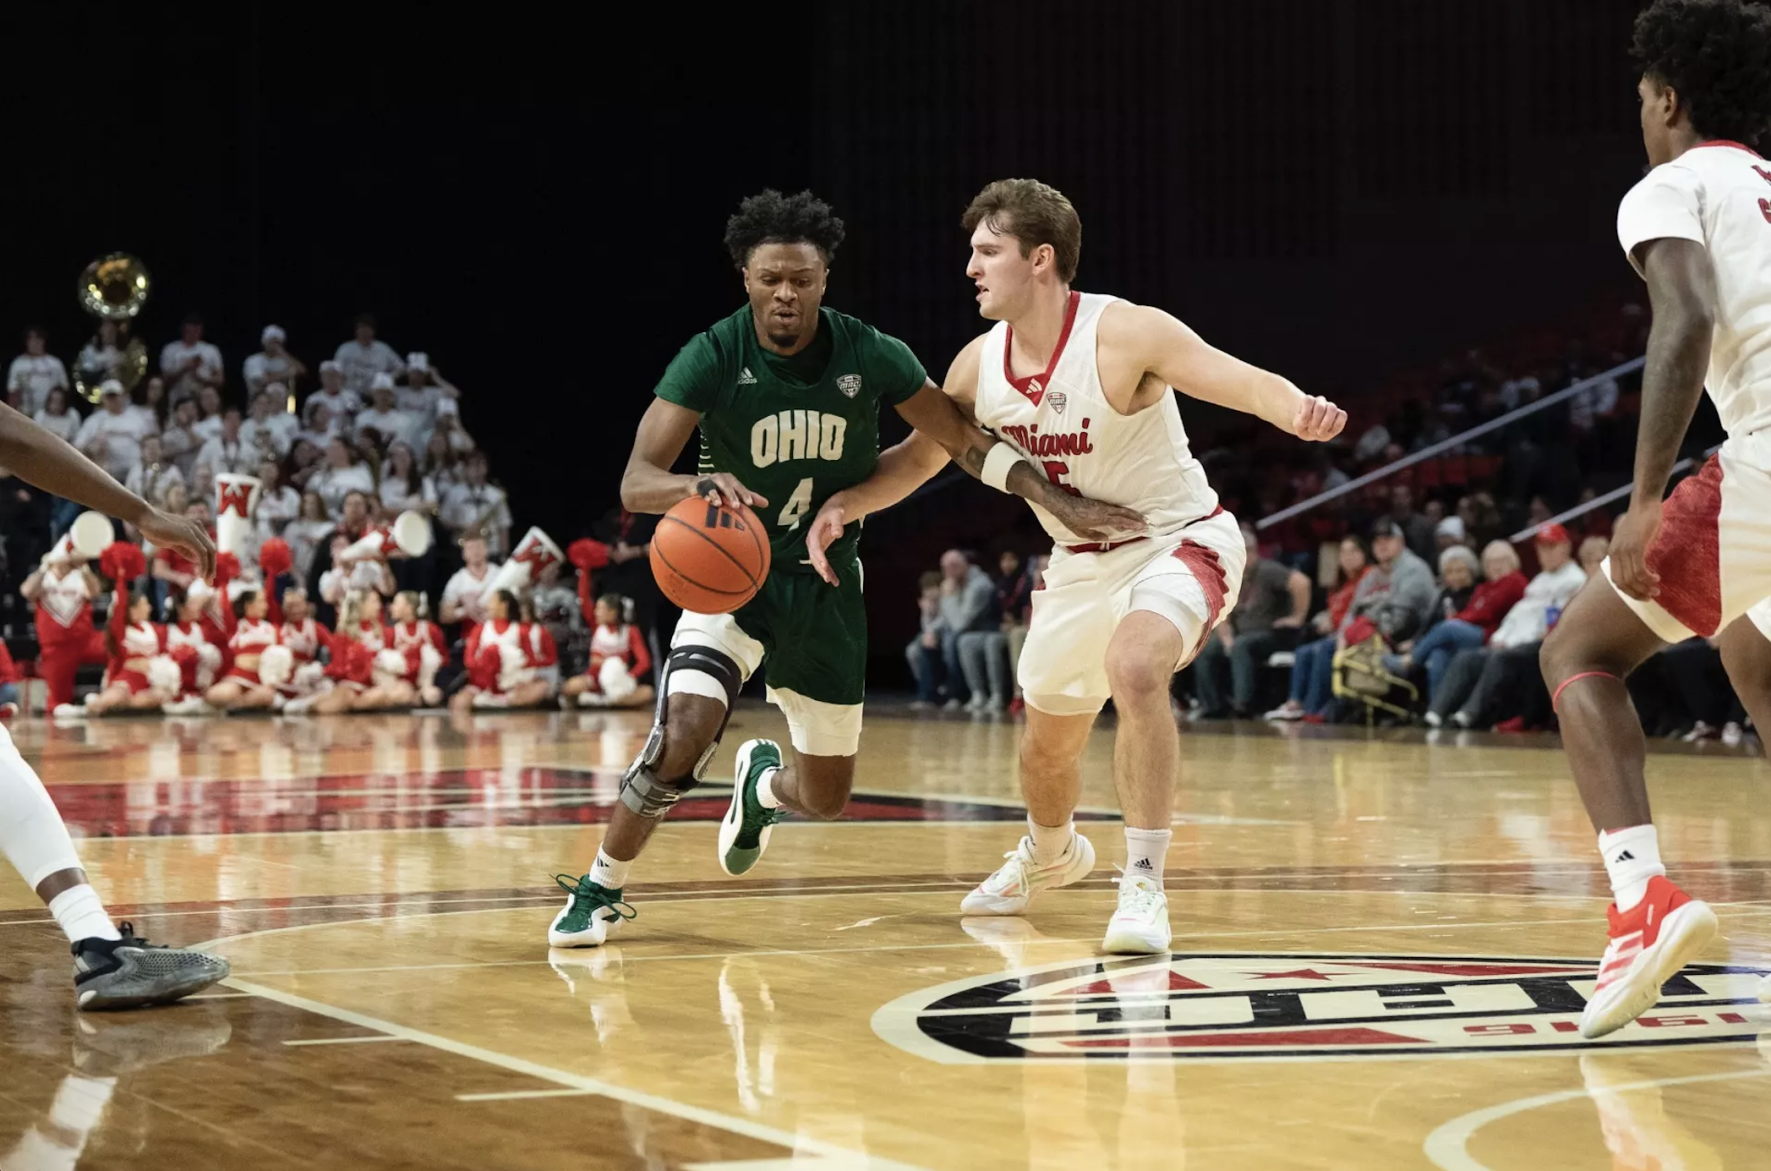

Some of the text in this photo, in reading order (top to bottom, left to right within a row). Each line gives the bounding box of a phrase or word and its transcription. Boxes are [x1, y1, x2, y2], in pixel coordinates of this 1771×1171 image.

[751, 409, 847, 468] OHIO
[1001, 418, 1093, 457] Miami
[1041, 461, 1083, 498] 5
[777, 477, 813, 531] 4
